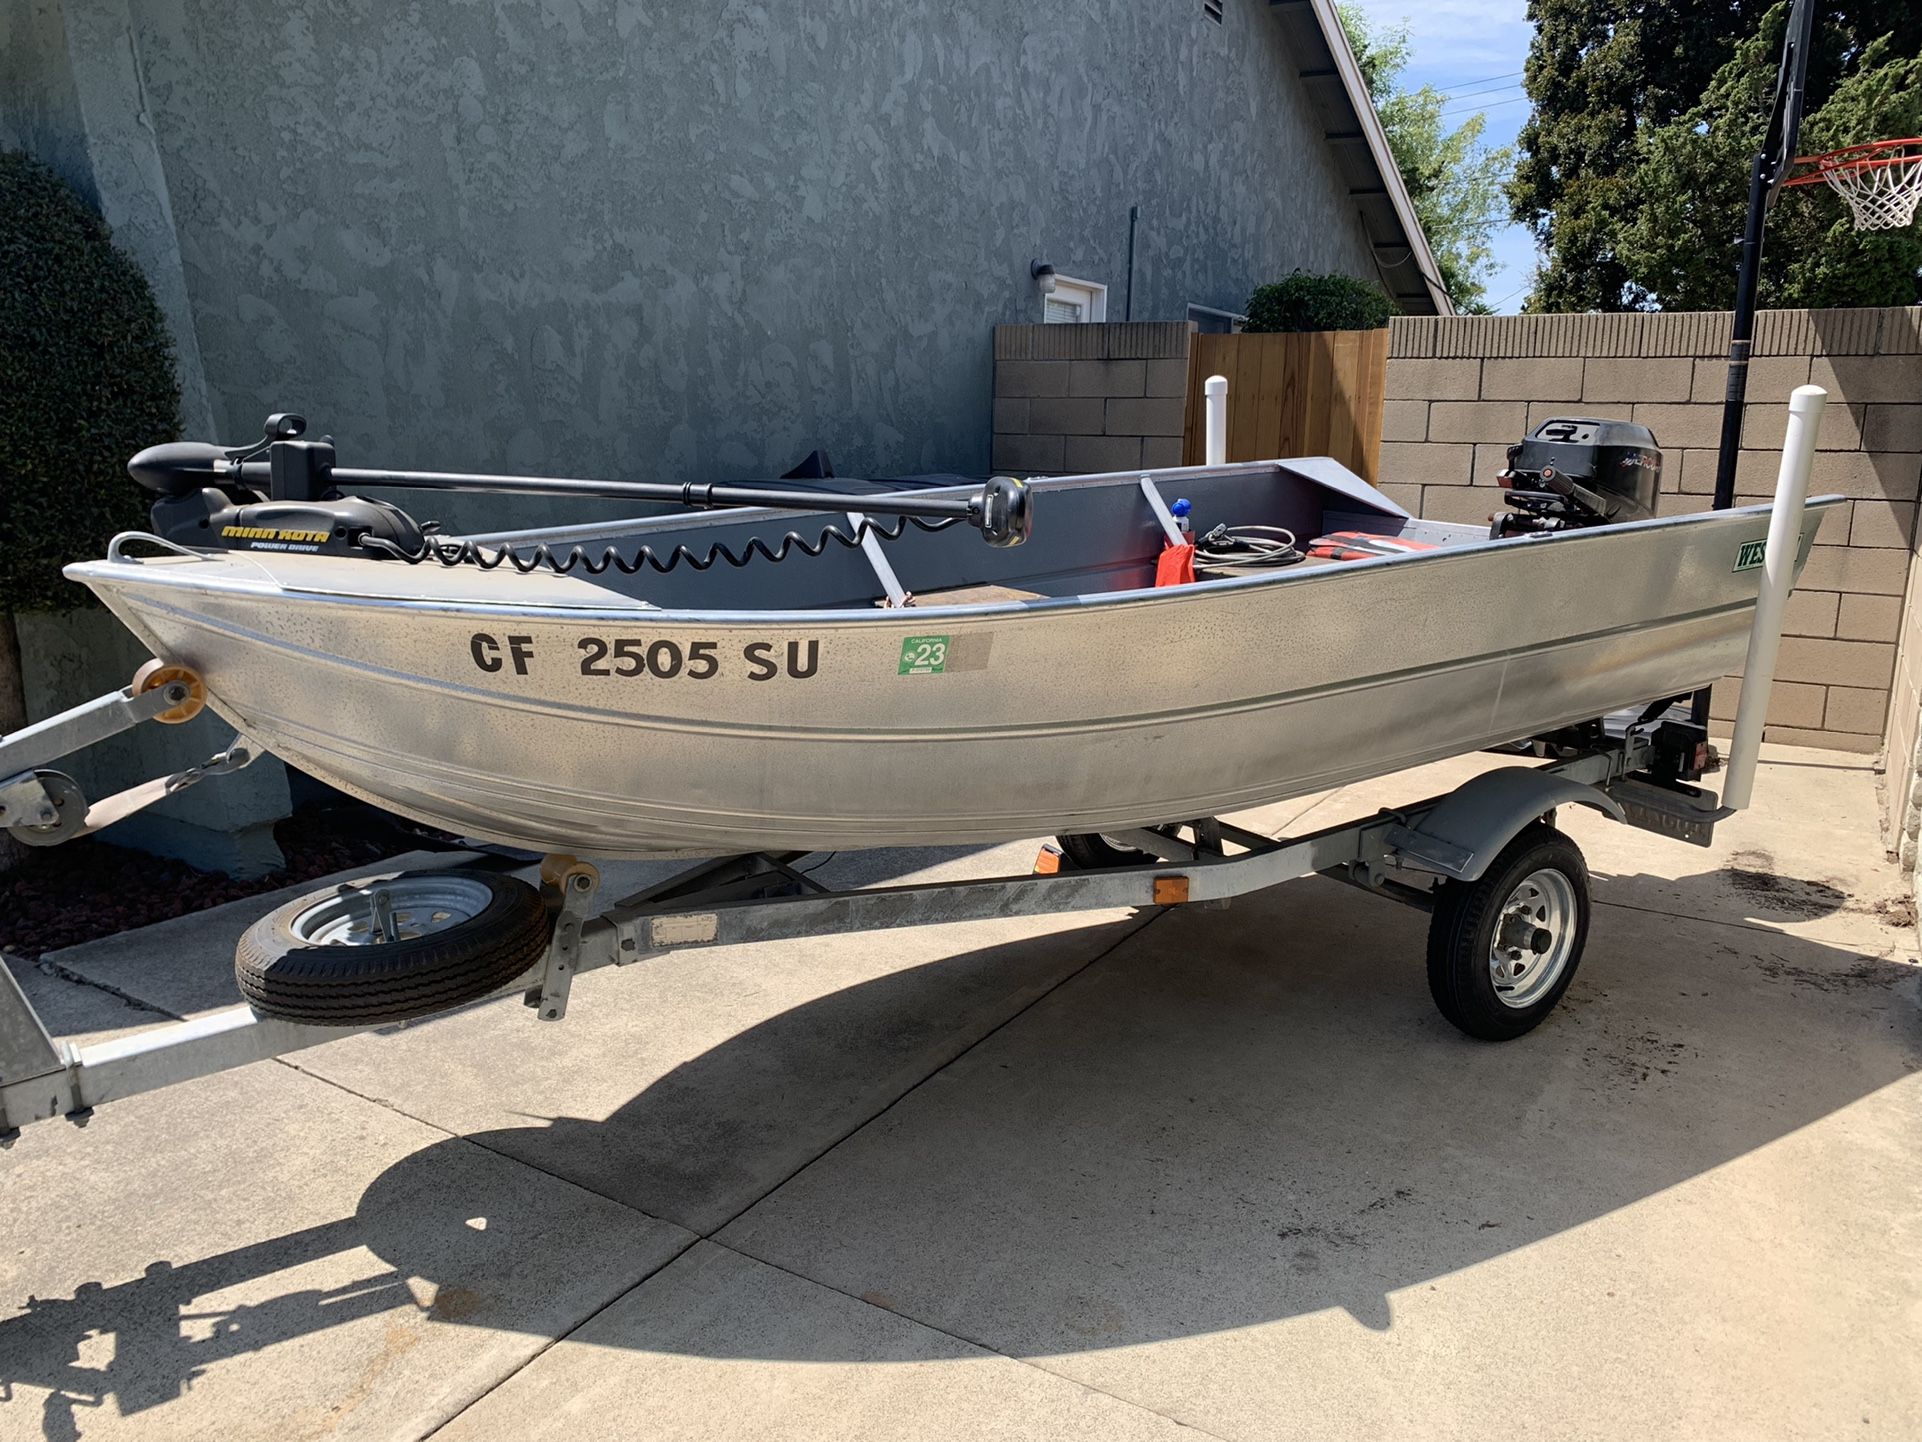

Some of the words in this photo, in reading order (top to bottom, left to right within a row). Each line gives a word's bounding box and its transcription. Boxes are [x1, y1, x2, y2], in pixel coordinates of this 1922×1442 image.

[221, 525, 279, 539] MINN
[278, 529, 331, 543] KOTA
[250, 541, 287, 550] POWER
[288, 543, 319, 552] DRIVE
[470, 633, 534, 675] CF
[577, 637, 719, 680] 2505
[743, 640, 819, 681] SU
[914, 643, 945, 666] 23
